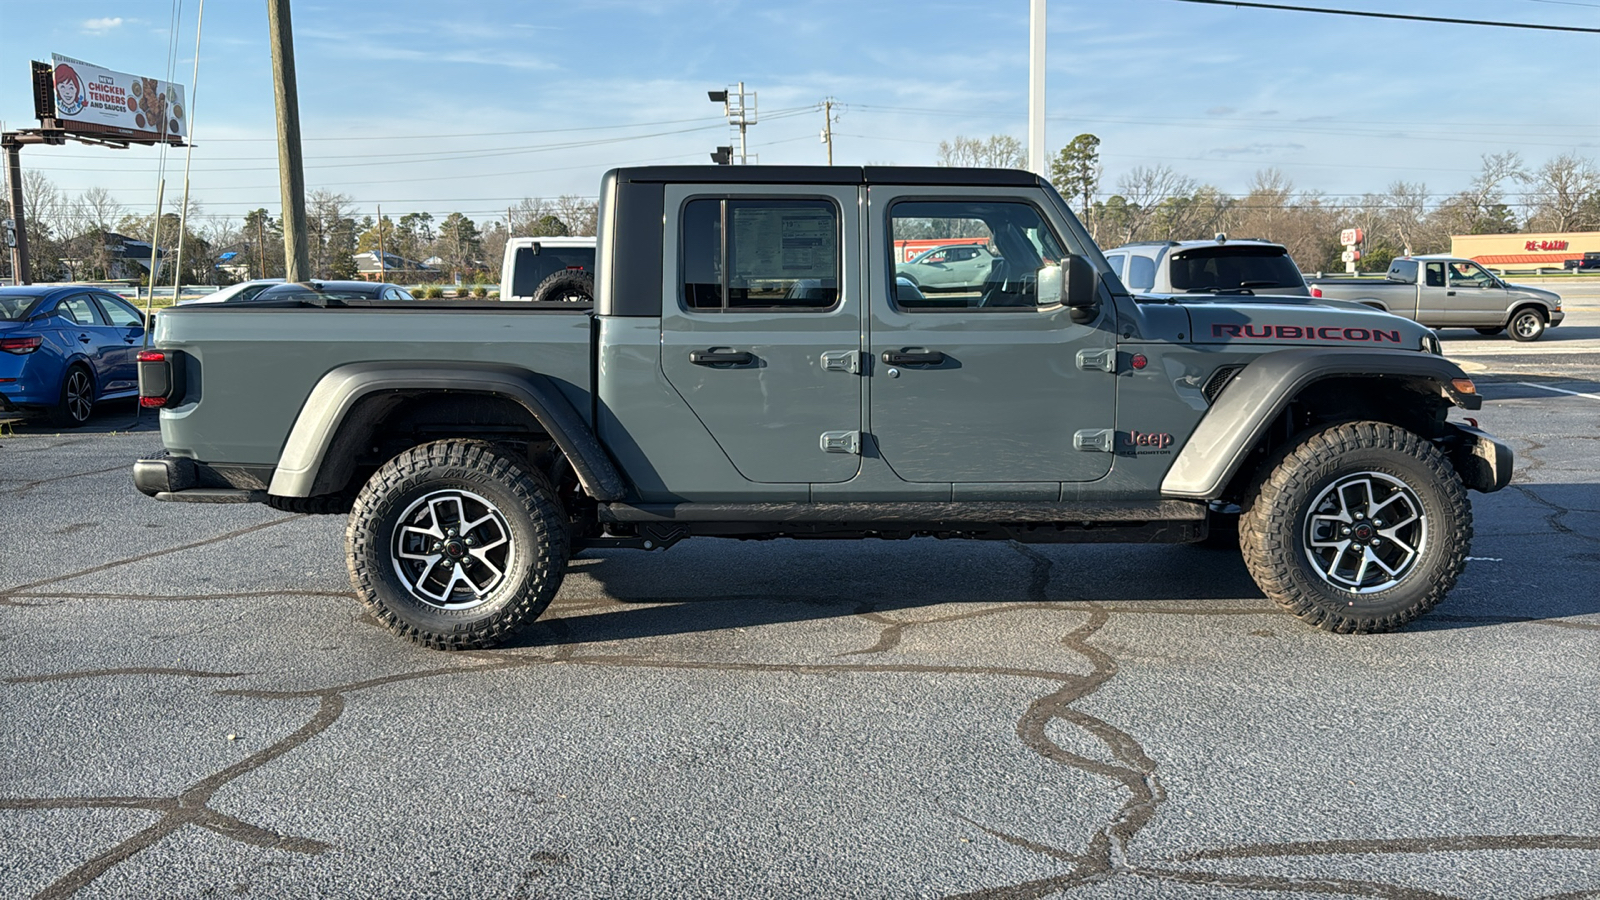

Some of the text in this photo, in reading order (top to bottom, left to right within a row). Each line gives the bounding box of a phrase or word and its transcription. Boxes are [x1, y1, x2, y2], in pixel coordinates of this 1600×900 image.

[99, 75, 113, 85] NEW
[88, 82, 125, 95] CHICKEN
[89, 91, 126, 105] TENDERS
[104, 103, 126, 112] SAUCES
[1211, 323, 1401, 343] RUBICON
[1123, 429, 1172, 449] Jeep
